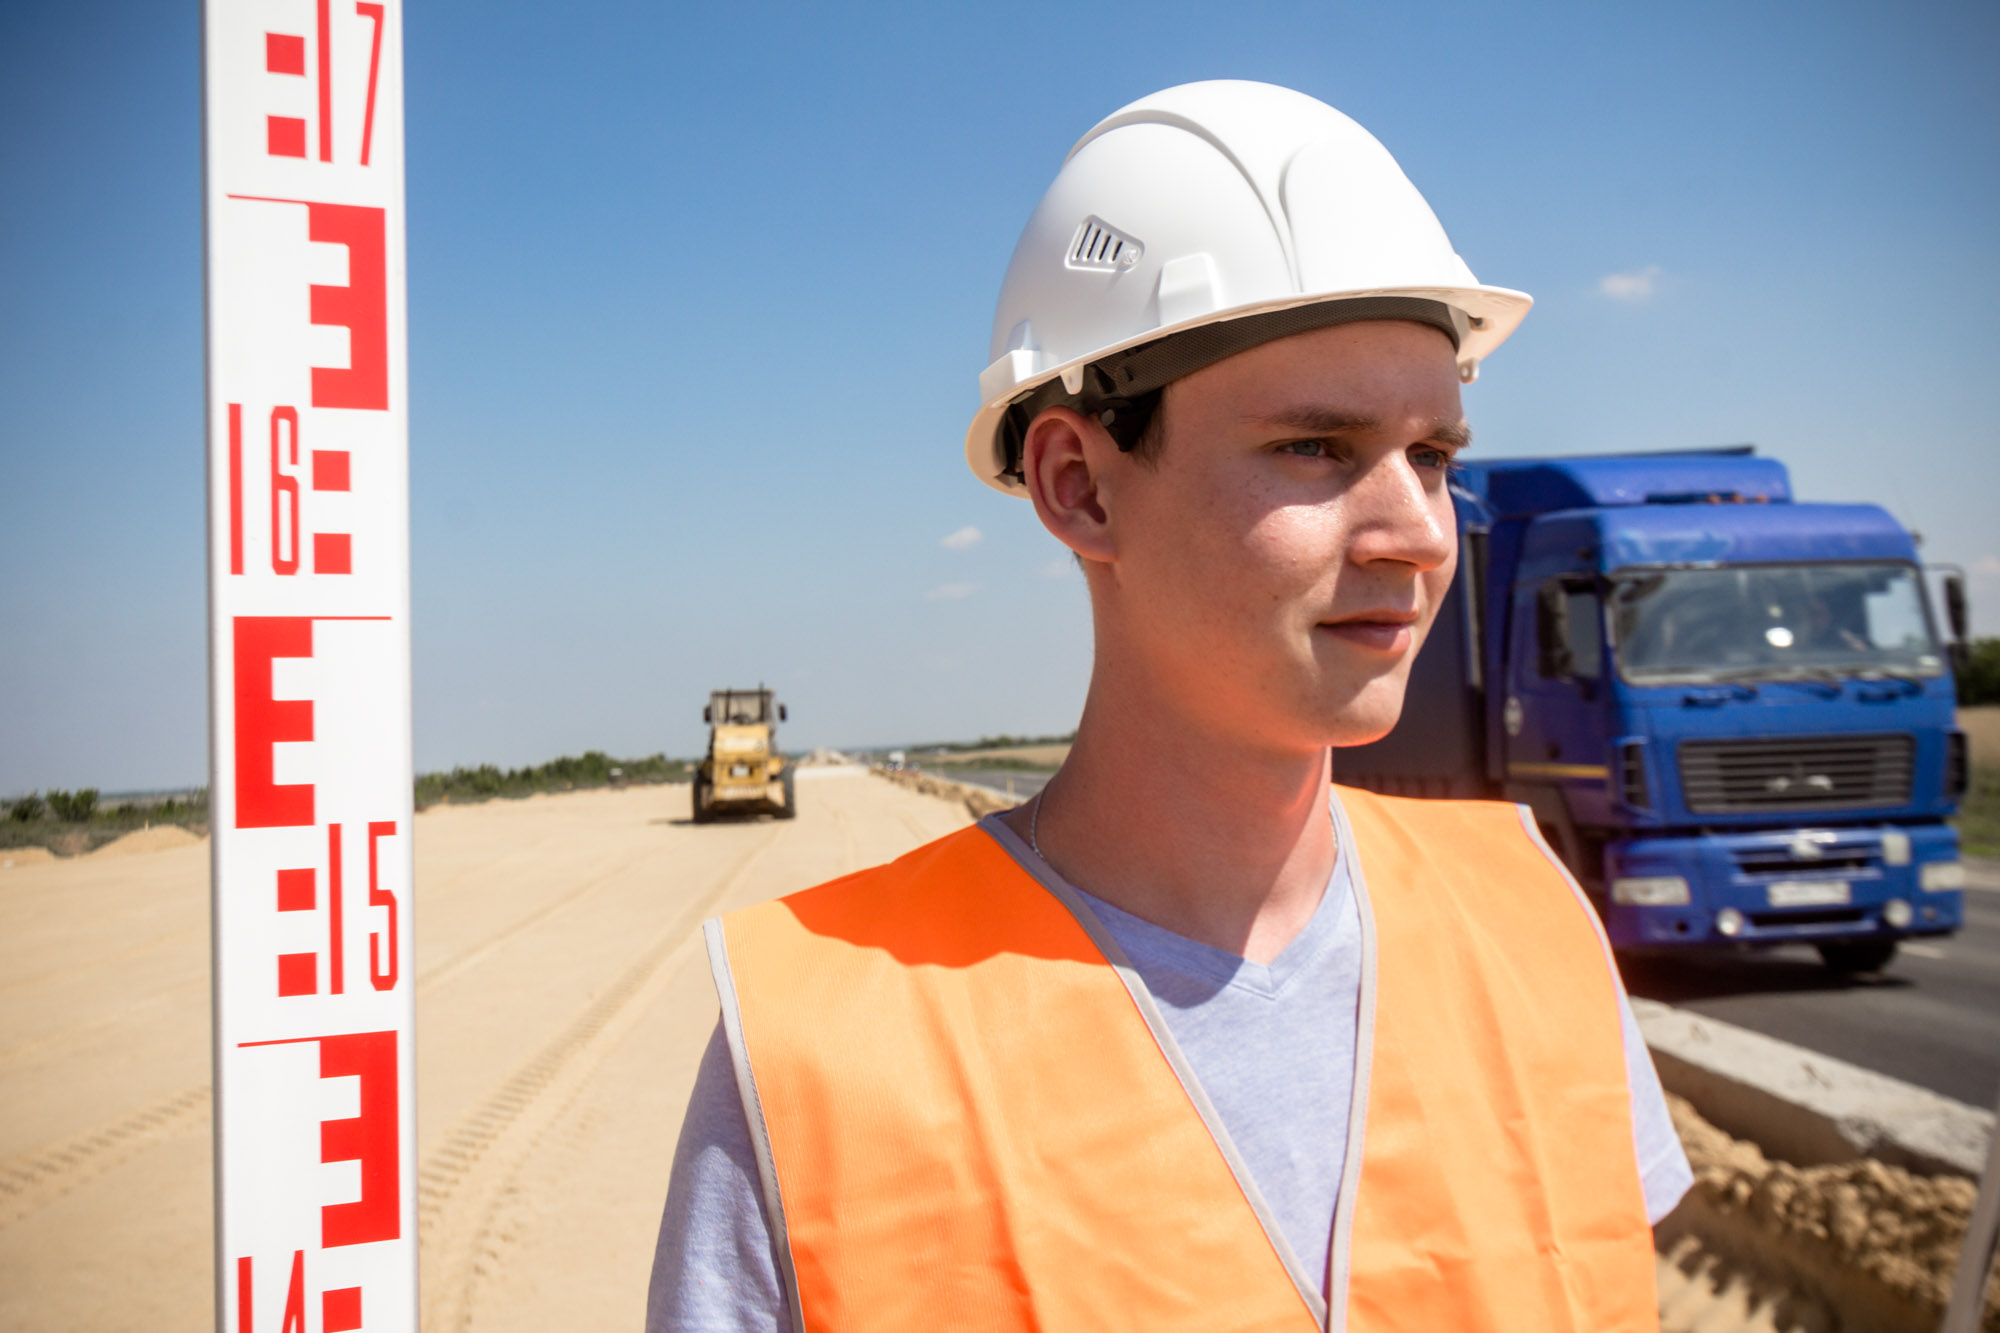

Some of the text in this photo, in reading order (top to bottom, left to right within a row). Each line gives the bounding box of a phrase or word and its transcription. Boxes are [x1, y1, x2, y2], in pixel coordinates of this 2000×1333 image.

[316, 0, 384, 166] 17
[228, 403, 299, 575] 16
[328, 821, 398, 995] 15
